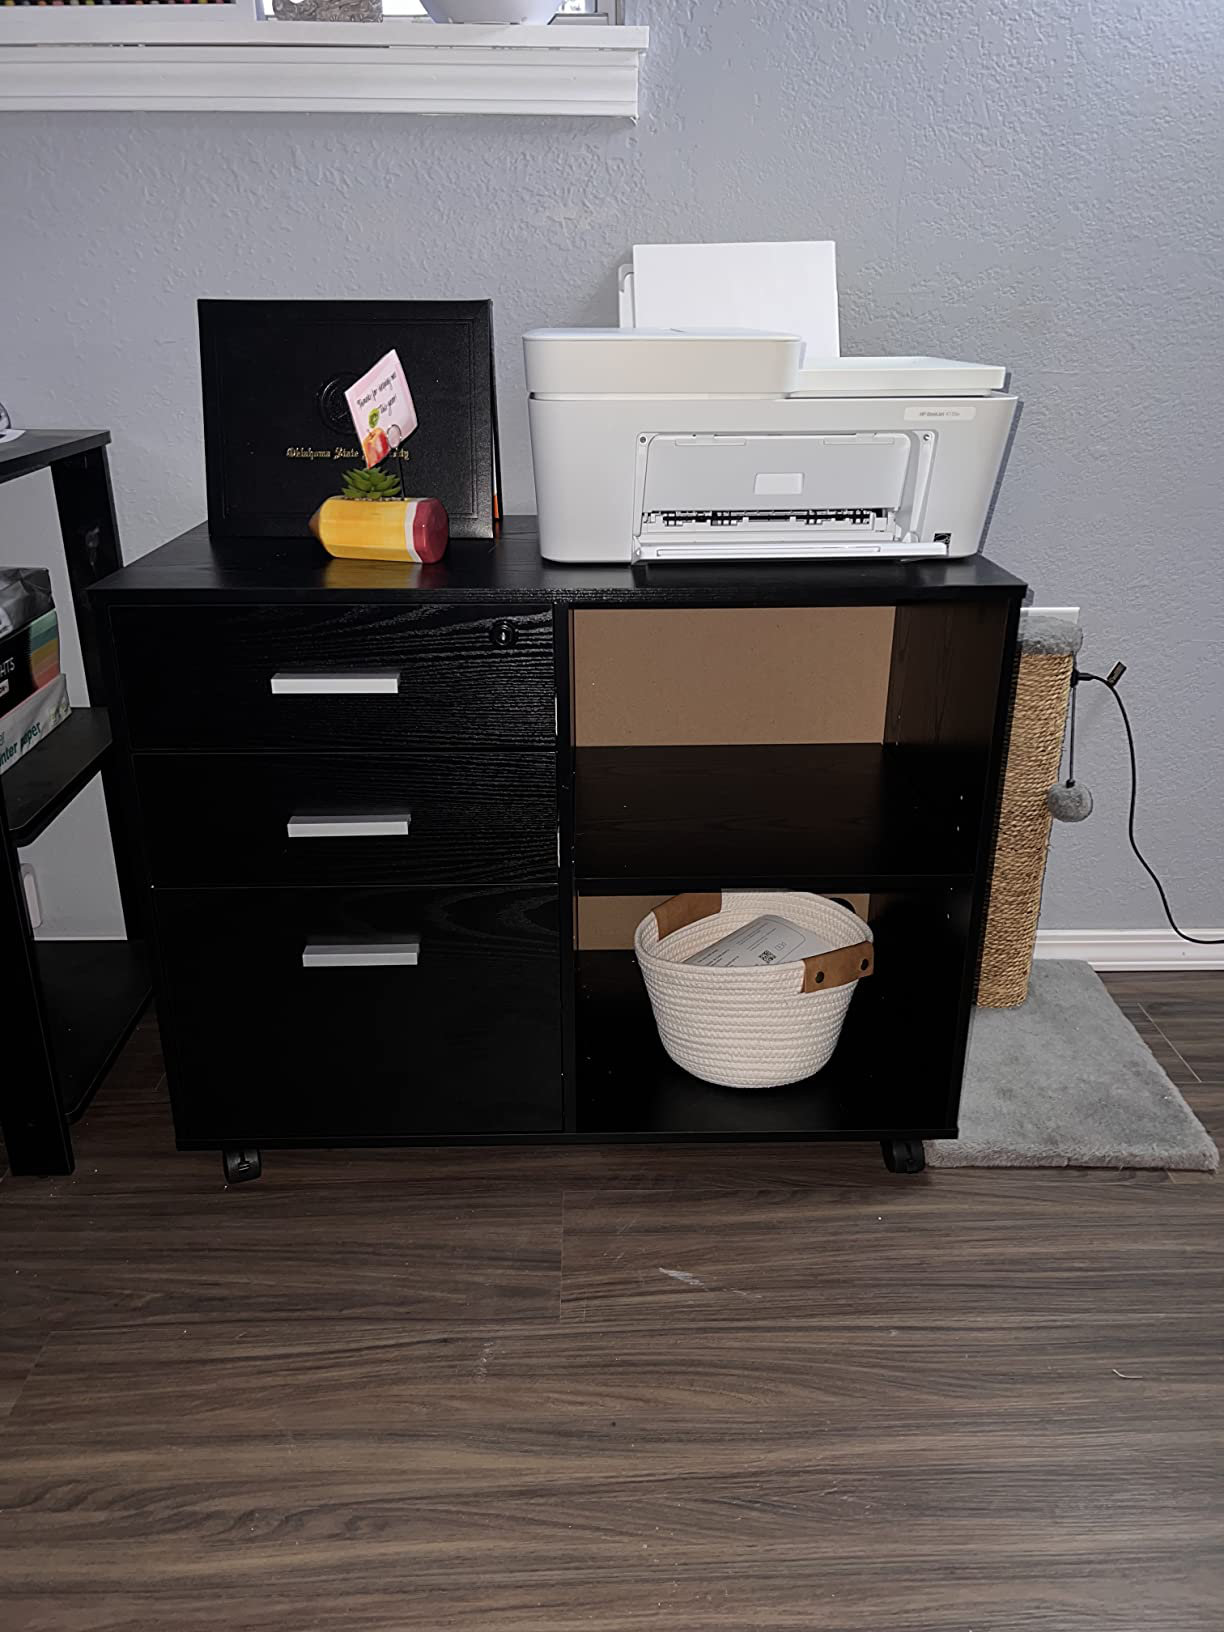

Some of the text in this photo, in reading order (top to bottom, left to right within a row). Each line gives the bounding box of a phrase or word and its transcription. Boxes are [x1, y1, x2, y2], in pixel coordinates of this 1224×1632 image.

[286, 447, 331, 460] Oklahoma
[333, 447, 360, 460] State
[20, 721, 41, 753] paper
